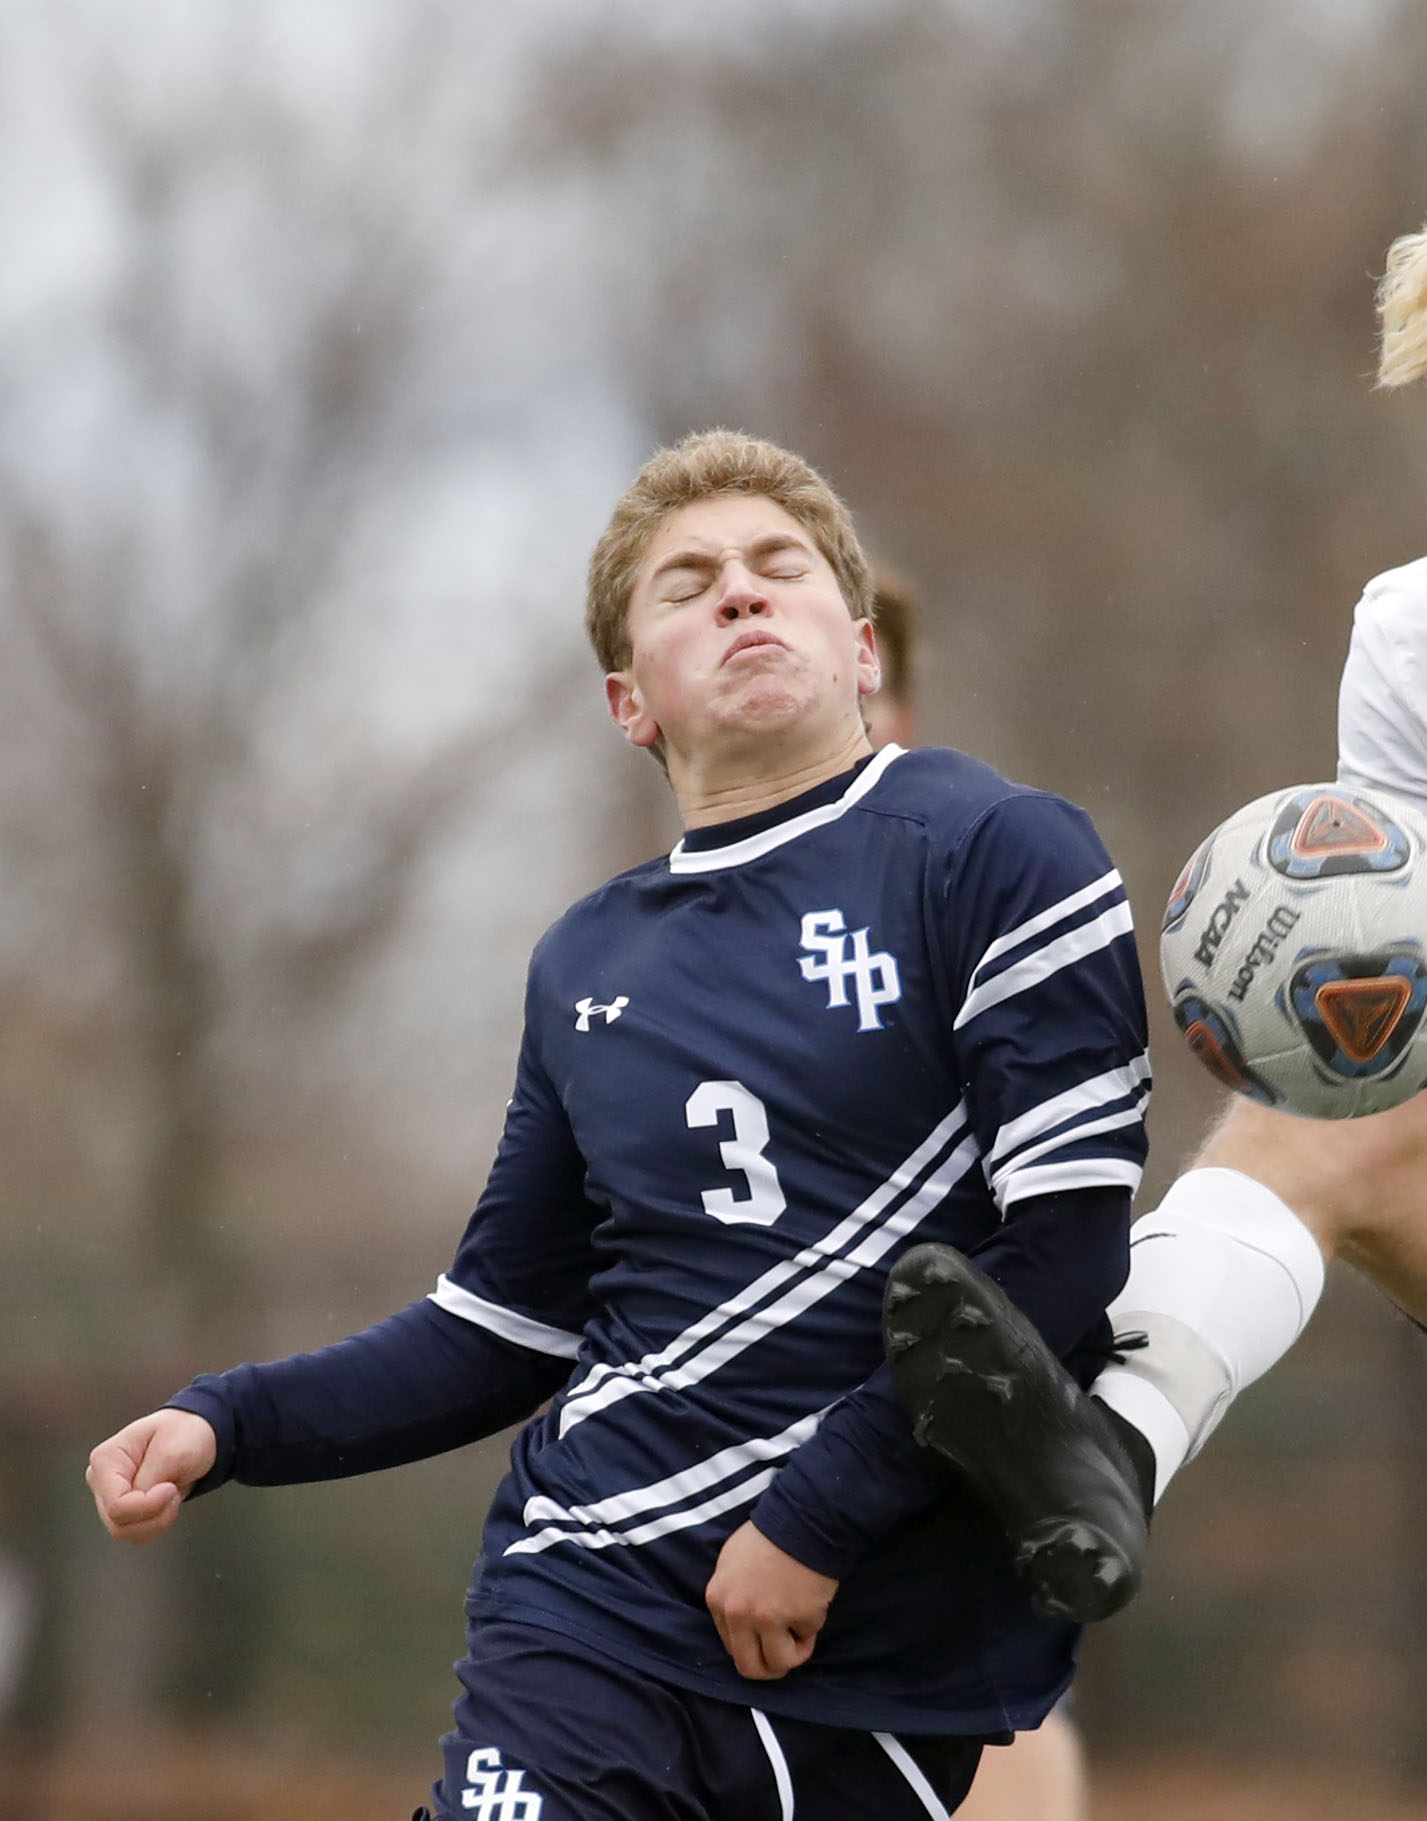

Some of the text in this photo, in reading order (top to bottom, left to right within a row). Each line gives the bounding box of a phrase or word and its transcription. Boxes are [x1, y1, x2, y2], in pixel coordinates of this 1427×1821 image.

[1194, 879, 1250, 968] NCAA
[1229, 905, 1301, 1003] Wilson
[684, 1080, 787, 1226] 3
